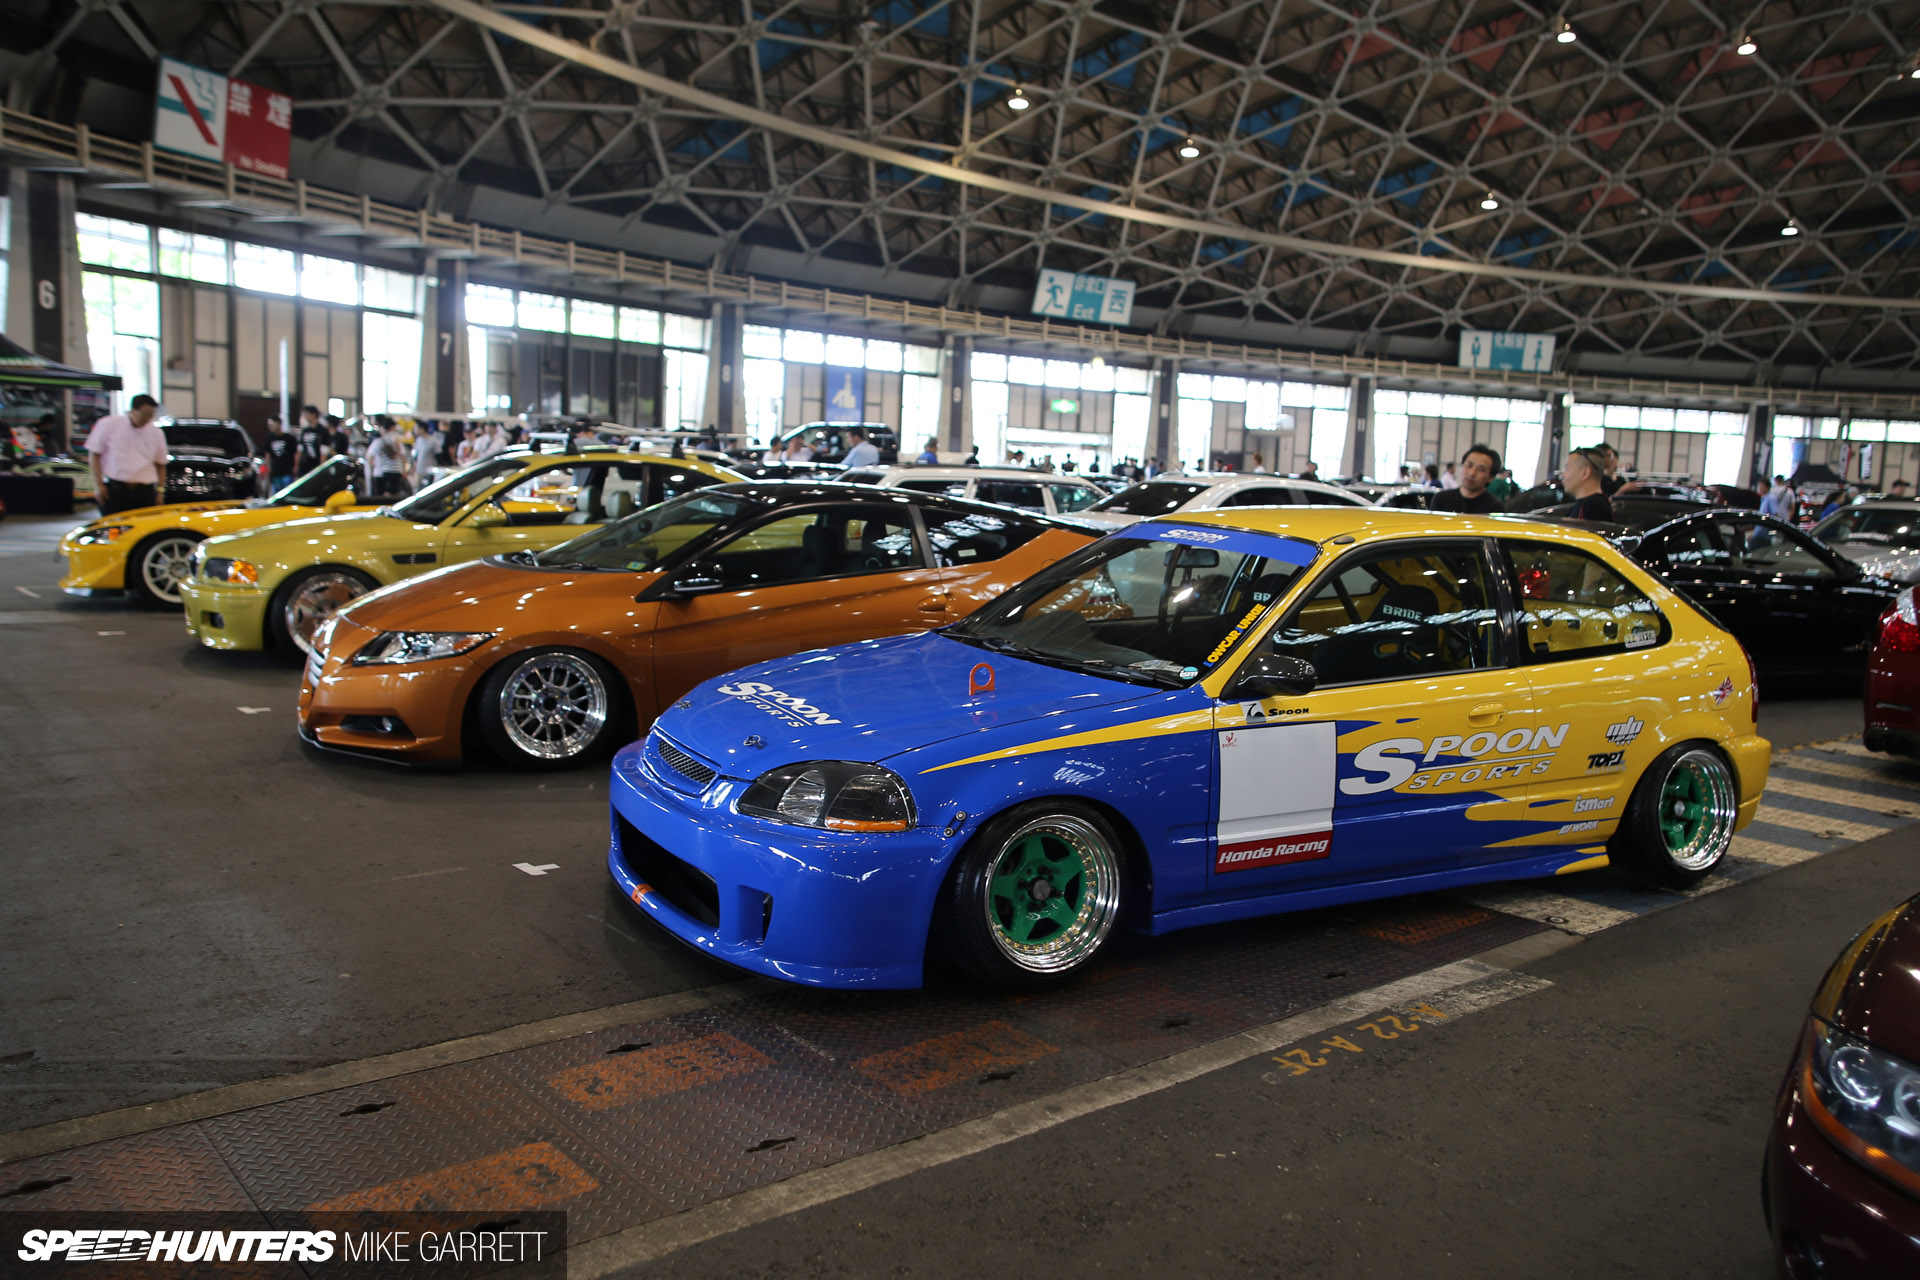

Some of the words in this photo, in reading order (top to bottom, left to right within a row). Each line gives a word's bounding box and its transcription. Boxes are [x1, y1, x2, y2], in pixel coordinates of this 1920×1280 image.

[39, 279, 56, 310] 6
[1072, 303, 1095, 320] Exit
[440, 332, 452, 355] 7
[1160, 529, 1230, 540] SPOON
[1382, 604, 1423, 622] BRIDE
[717, 682, 842, 726] SPOON
[737, 695, 805, 728] SPORTS
[1268, 707, 1310, 717] SPOON
[1339, 723, 1571, 796] SPOON
[1408, 760, 1552, 789] SPORTS
[1571, 820, 1599, 833] WORK
[1218, 847, 1273, 864] Honda
[1274, 839, 1329, 857] Racing
[1355, 1002, 1449, 1040] A-22
